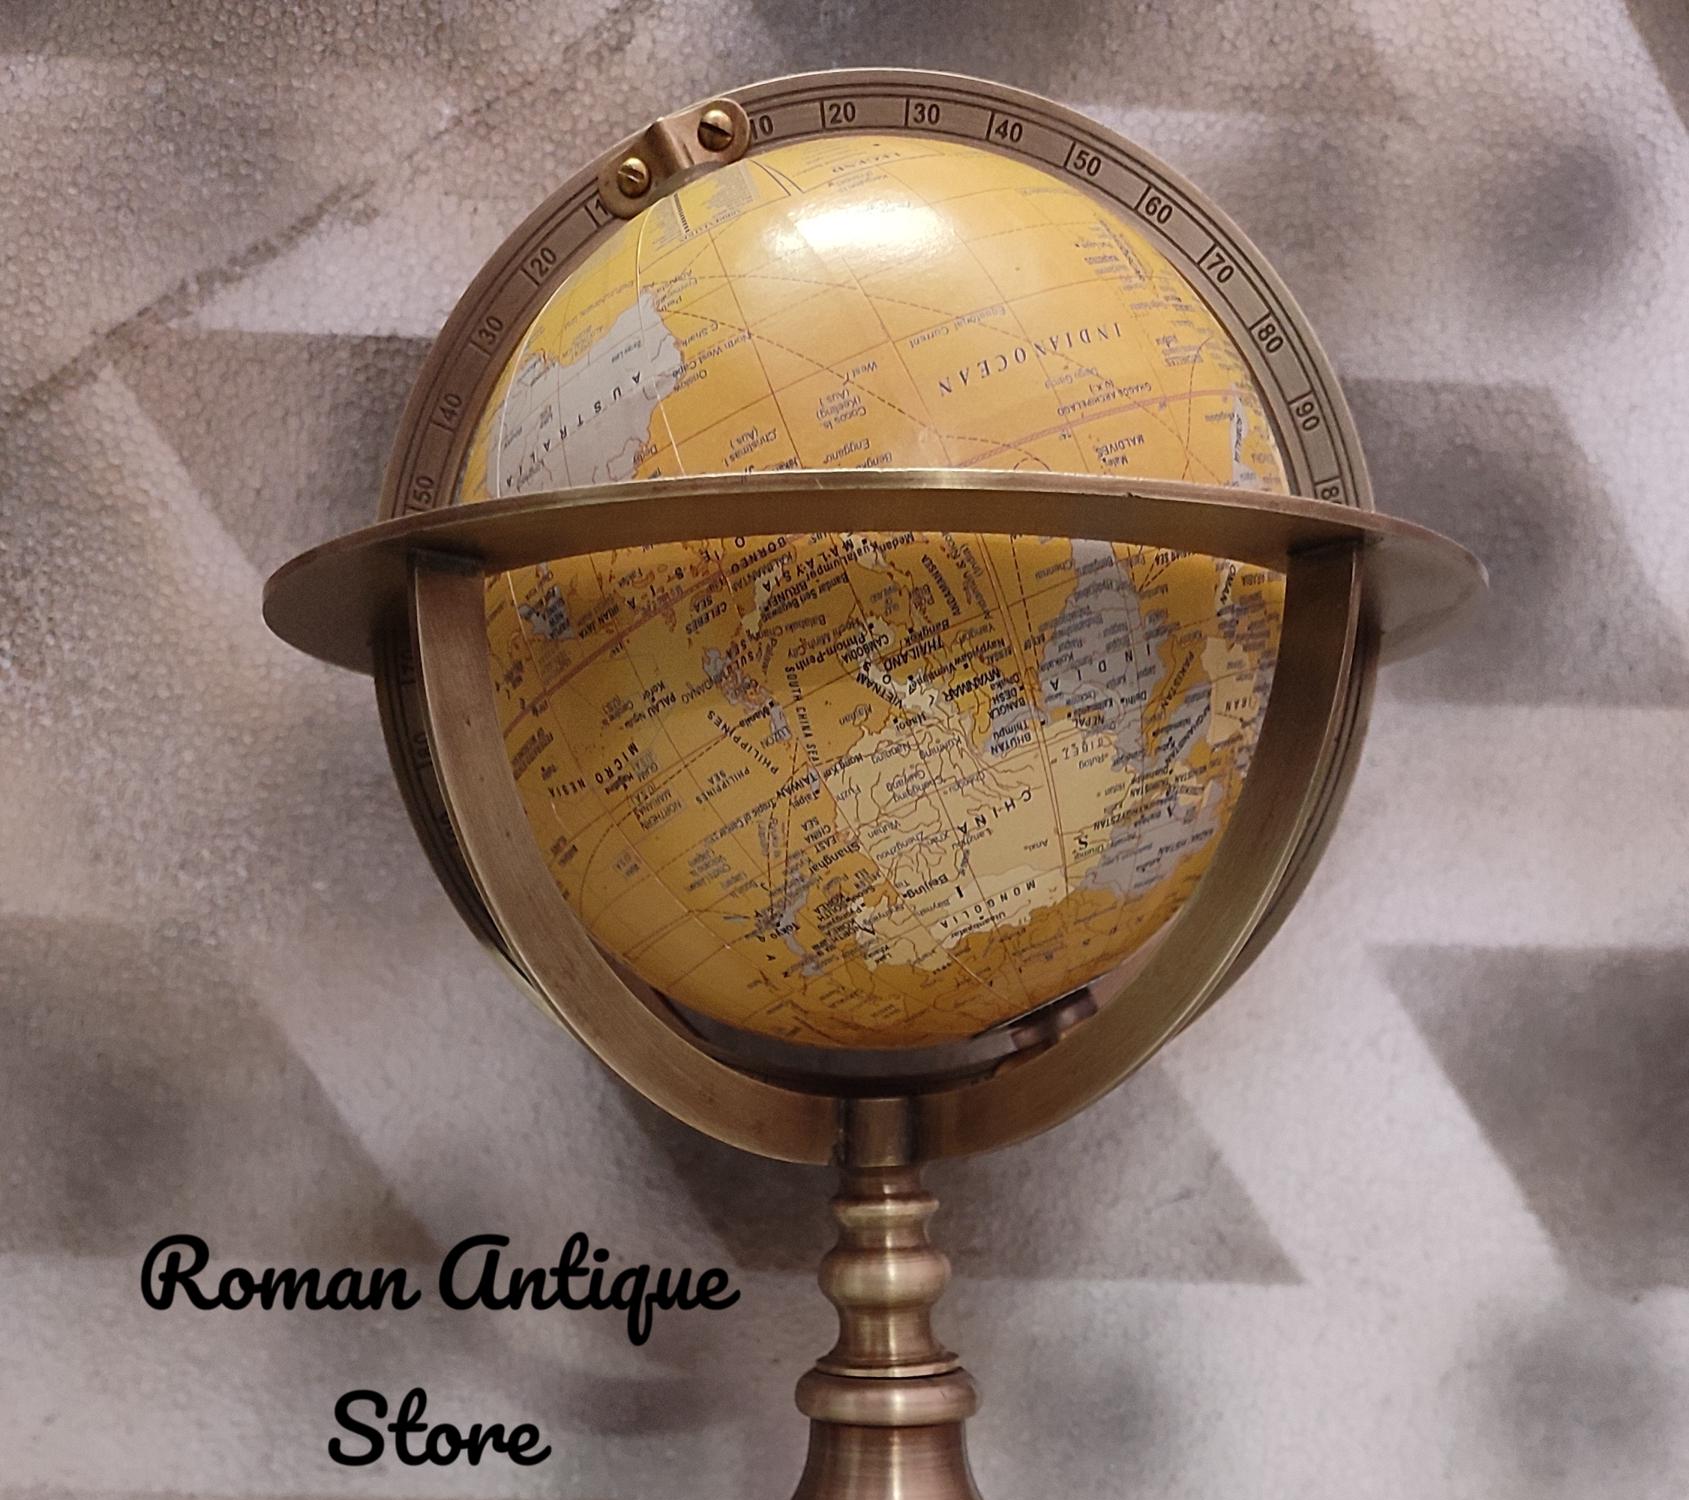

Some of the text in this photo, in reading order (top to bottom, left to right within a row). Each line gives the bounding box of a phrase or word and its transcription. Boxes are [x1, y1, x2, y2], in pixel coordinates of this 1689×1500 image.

[828, 101, 856, 124] 20
[913, 103, 940, 126] 30
[995, 119, 1024, 144] 40
[1073, 151, 1102, 178] 50
[1145, 198, 1174, 225] 60
[534, 246, 558, 275] 20
[1213, 252, 1236, 284] 70
[478, 315, 504, 348] 30
[1033, 322, 1121, 358] INDIAN
[1257, 324, 1284, 354] 80
[937, 347, 1026, 396] OCEAN
[440, 393, 463, 421] 40
[1296, 402, 1320, 431] 90
[1094, 433, 1144, 457] MALDIVES
[413, 476, 434, 506] 50
[1321, 486, 1342, 505] 8
[729, 535, 786, 574] BORNEO
[840, 632, 889, 664] CAMBODIA
[883, 635, 942, 672] THAILAND
[1049, 642, 1150, 691] INDIA
[855, 672, 903, 708] VIETNAM
[941, 667, 1000, 702] MYANMAR
[646, 691, 677, 716] PALAU
[1070, 714, 1104, 728] NEPAL
[706, 709, 778, 774] PHILIPPINES
[694, 766, 750, 804] PHILIPPINES
[774, 771, 817, 799] TAIWAN
[957, 787, 1031, 834] CHINA
[808, 840, 860, 874] Shanghai
[813, 835, 836, 853] EAST
[907, 873, 948, 899] Beijing
[940, 879, 1035, 928] MONGOLIA
[769, 921, 799, 939] Tokyo
